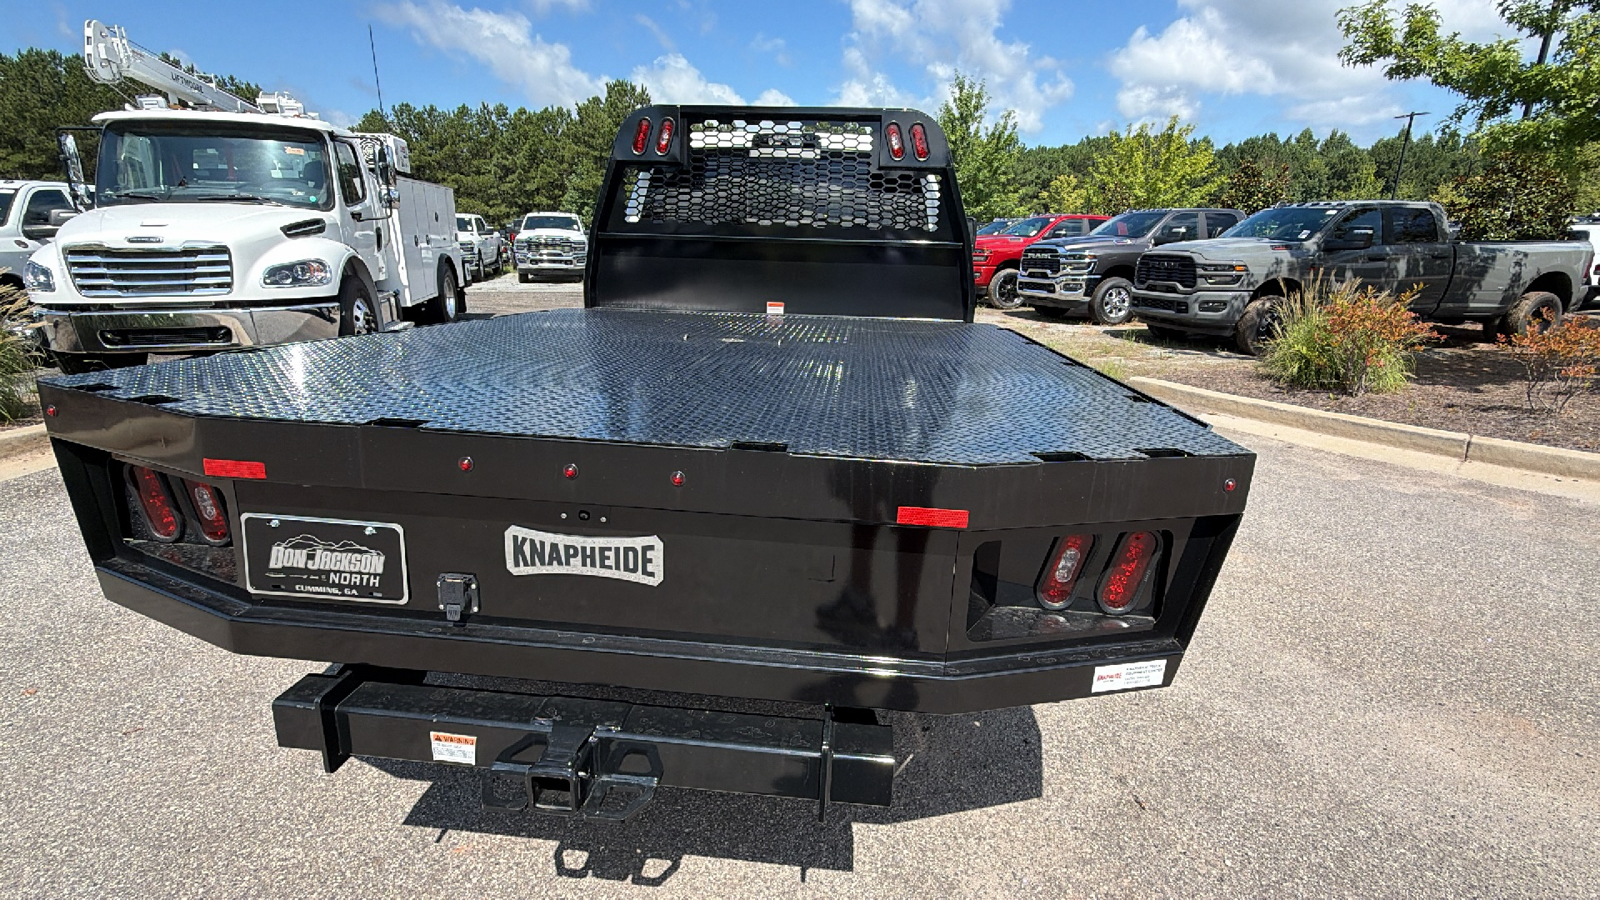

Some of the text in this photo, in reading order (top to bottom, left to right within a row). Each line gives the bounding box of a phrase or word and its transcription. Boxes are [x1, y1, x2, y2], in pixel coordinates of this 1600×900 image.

[1027, 252, 1051, 260] RAM
[268, 545, 386, 575] DON JACKSON
[512, 534, 656, 579] KNAPHEIDE
[329, 572, 380, 588] NORTH
[294, 584, 359, 597] CUMMING, GA
[443, 736, 474, 746] WARNING
